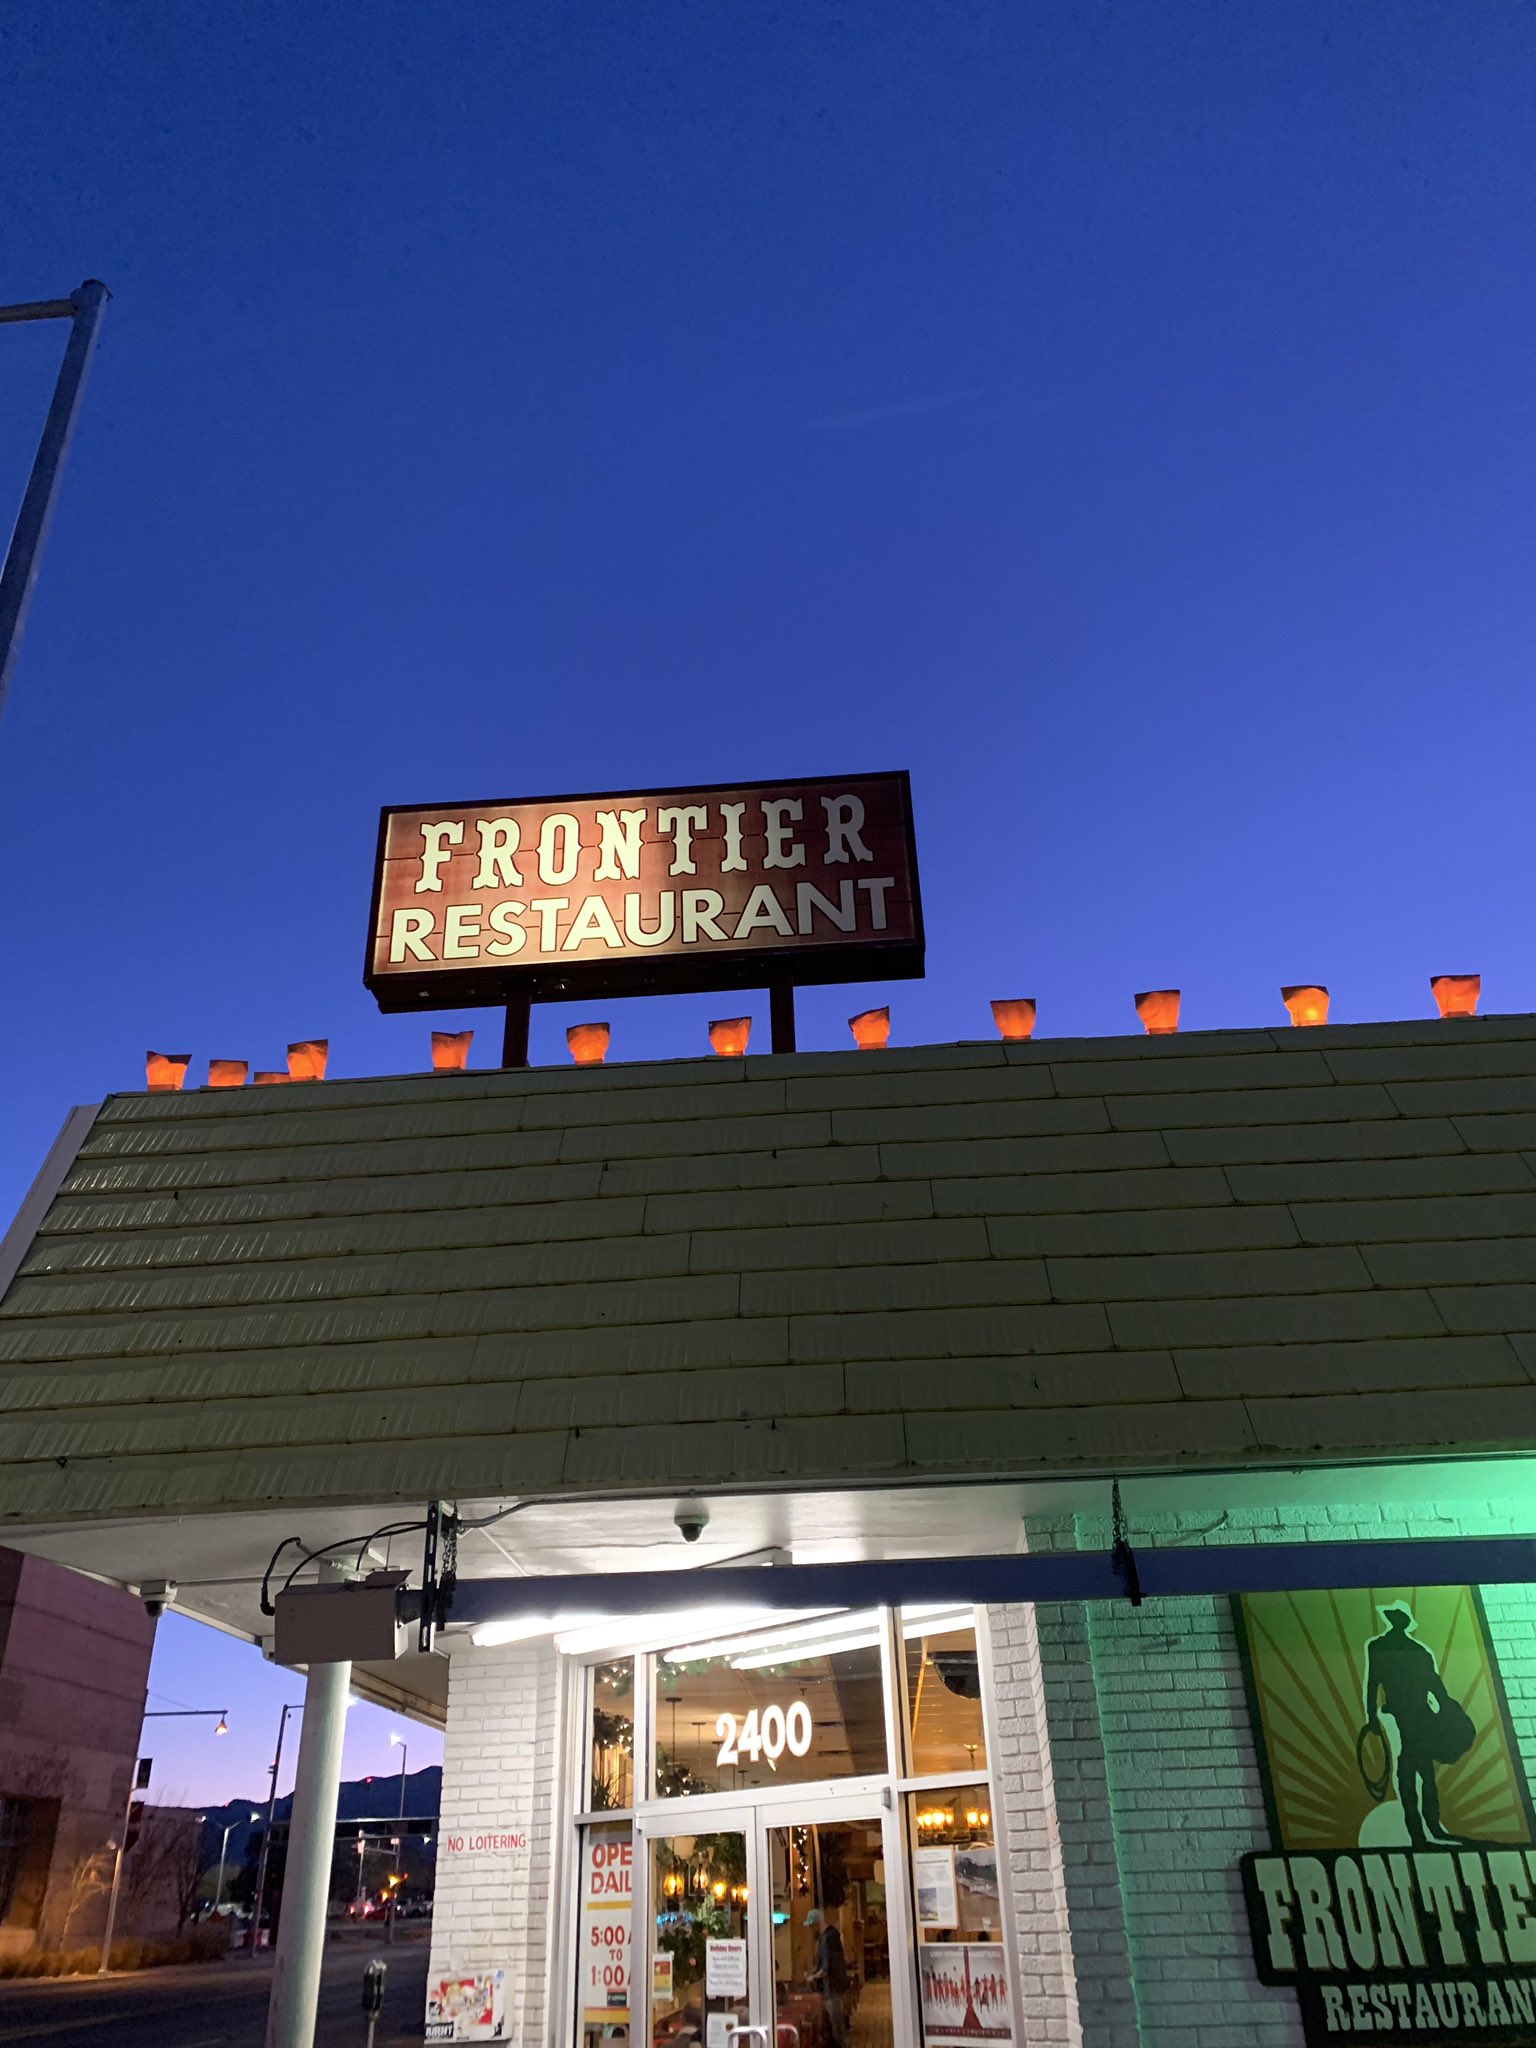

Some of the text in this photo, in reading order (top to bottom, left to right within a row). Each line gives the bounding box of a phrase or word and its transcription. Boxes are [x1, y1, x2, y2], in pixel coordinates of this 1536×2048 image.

[414, 793, 874, 893] FRONTIER
[388, 876, 896, 963] RESTAURANT
[716, 1700, 812, 1768] 2400
[447, 1833, 526, 1852] NO LOITERING
[591, 1842, 632, 1869] OPE
[591, 1870, 632, 1894] DAIL
[1254, 1851, 1536, 1971] FRONTIE
[591, 1925, 625, 1947] 5:00
[609, 1948, 623, 1961] TO
[591, 1965, 625, 1987] 1:00
[1320, 1979, 1536, 2033] RESTAURAN
